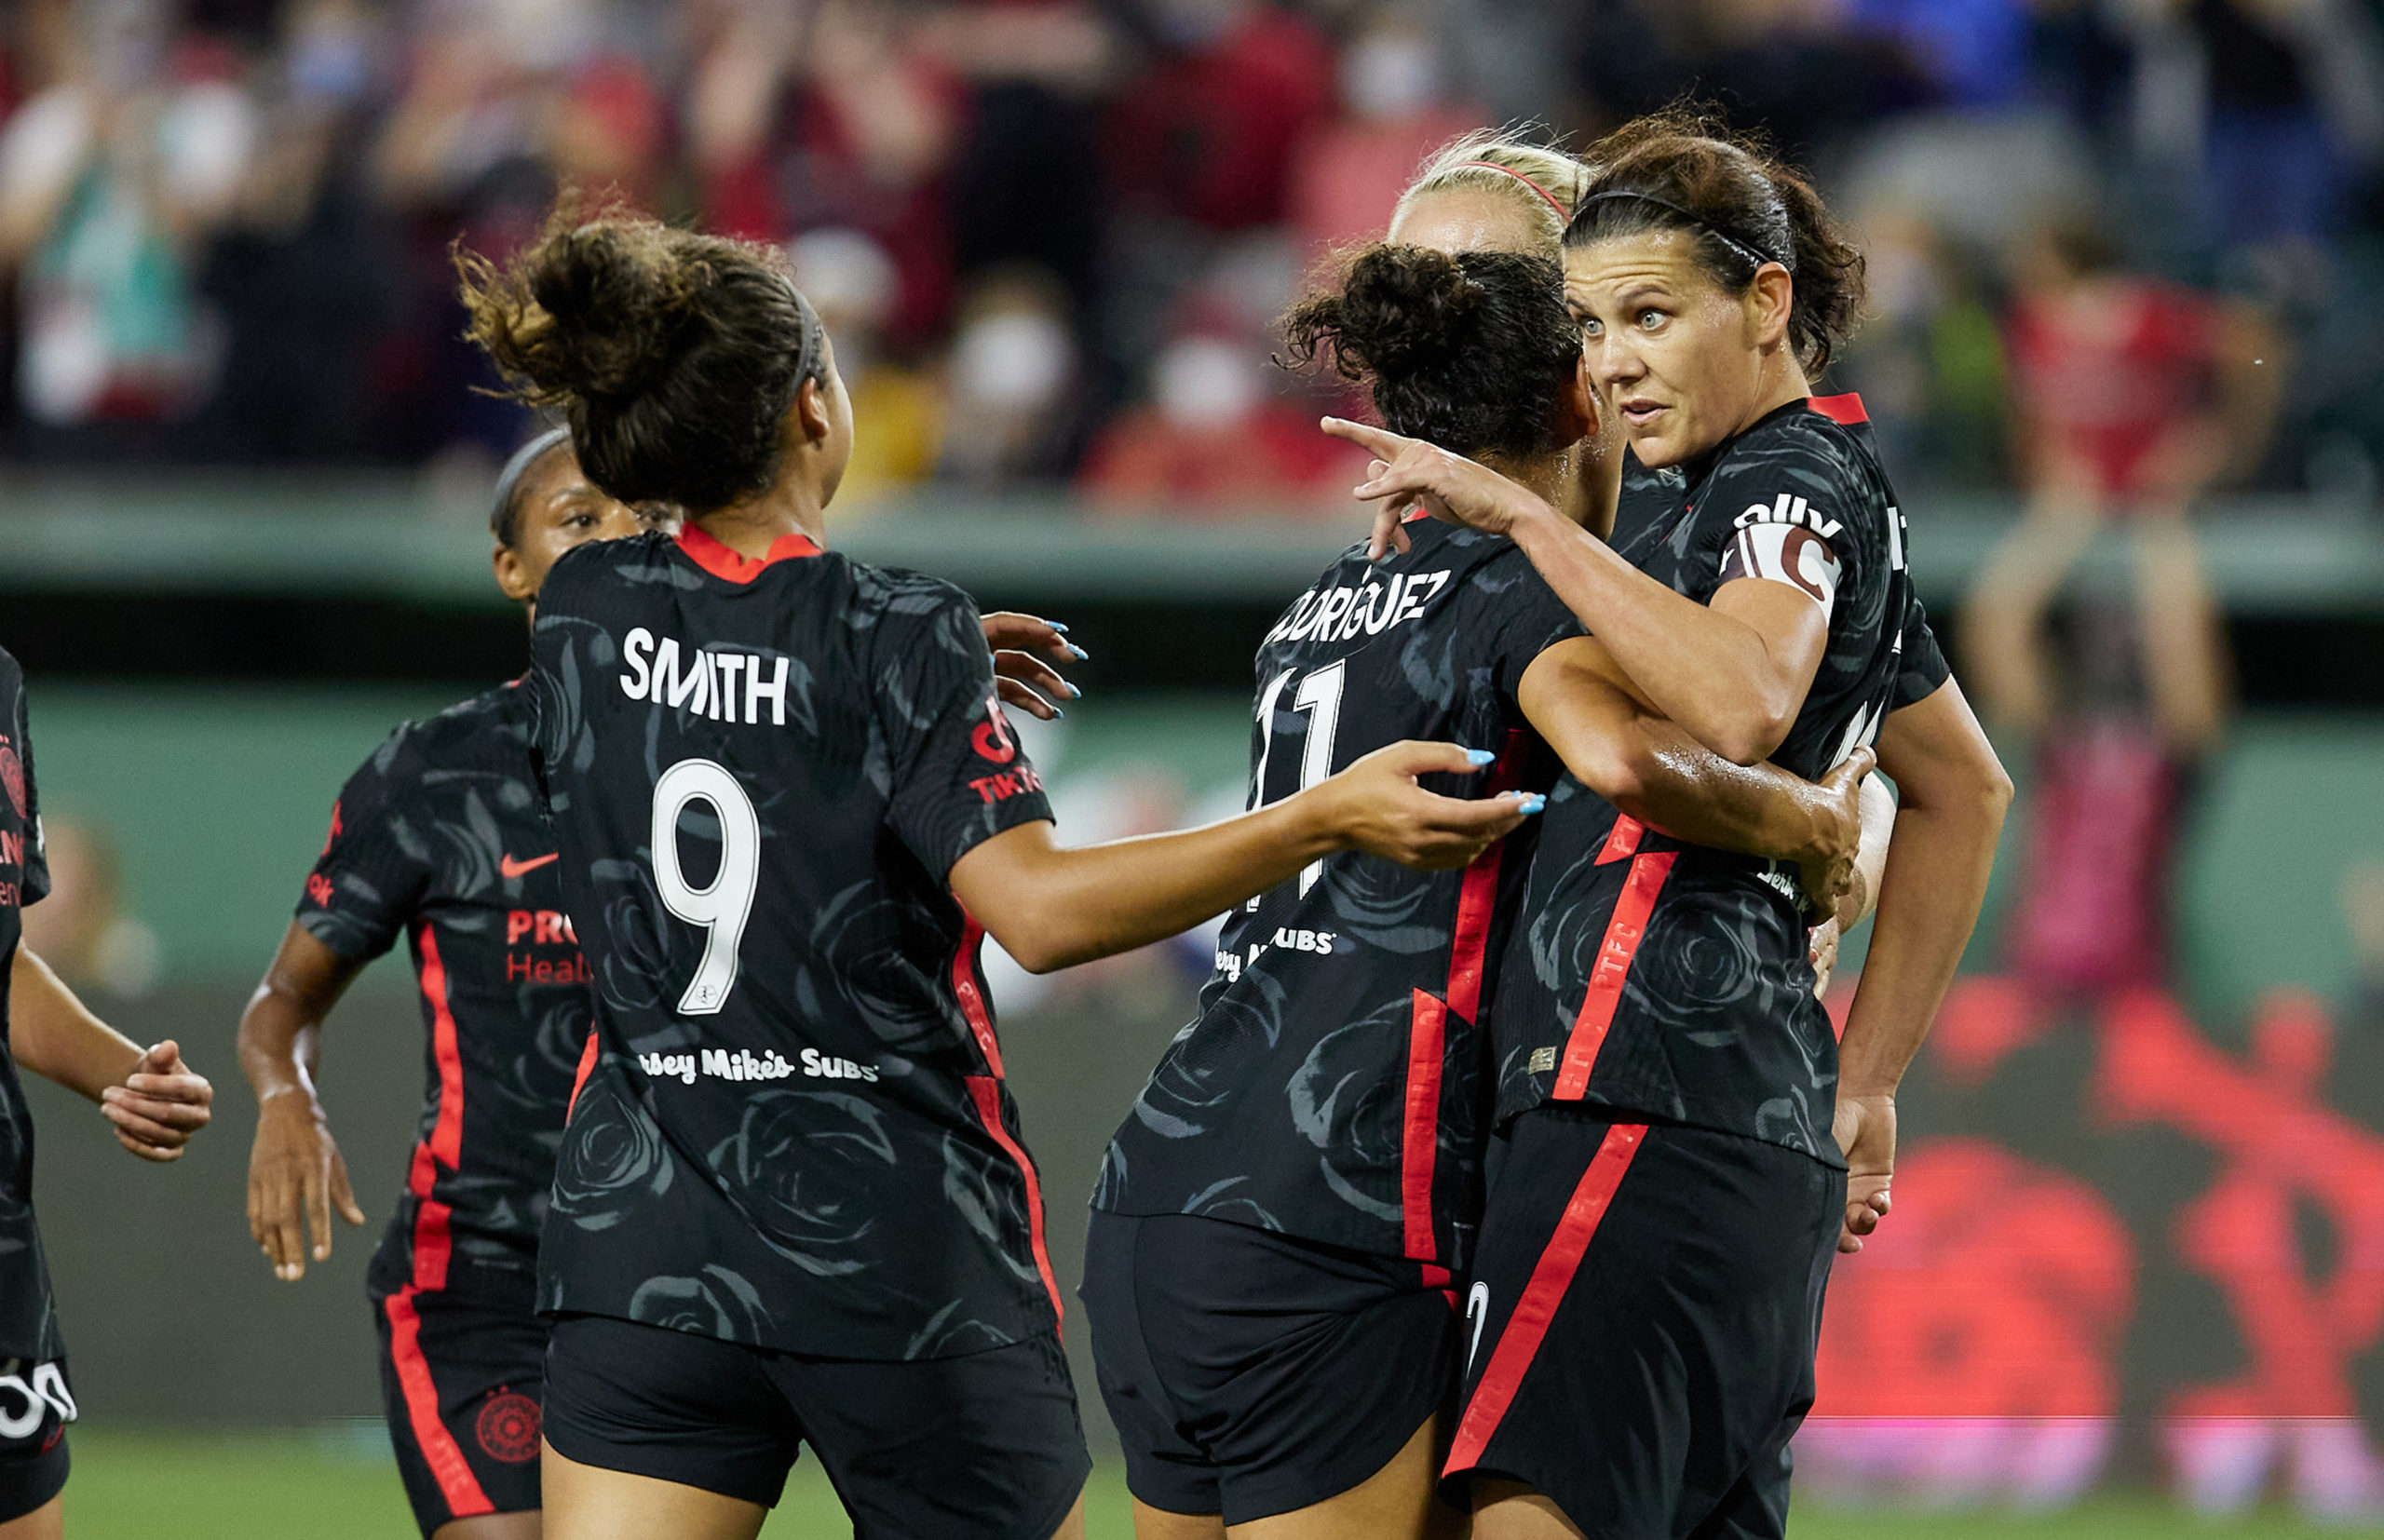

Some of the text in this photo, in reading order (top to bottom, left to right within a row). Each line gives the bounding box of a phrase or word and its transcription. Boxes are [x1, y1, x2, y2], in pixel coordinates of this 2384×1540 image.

[1734, 493, 1843, 538] ally
[1781, 526, 1835, 601] C
[619, 627, 789, 725] SMITH
[1246, 657, 1346, 912] 11
[651, 758, 761, 1015] 9
[1269, 927, 1334, 954] UBS
[701, 1049, 795, 1081] Mike's
